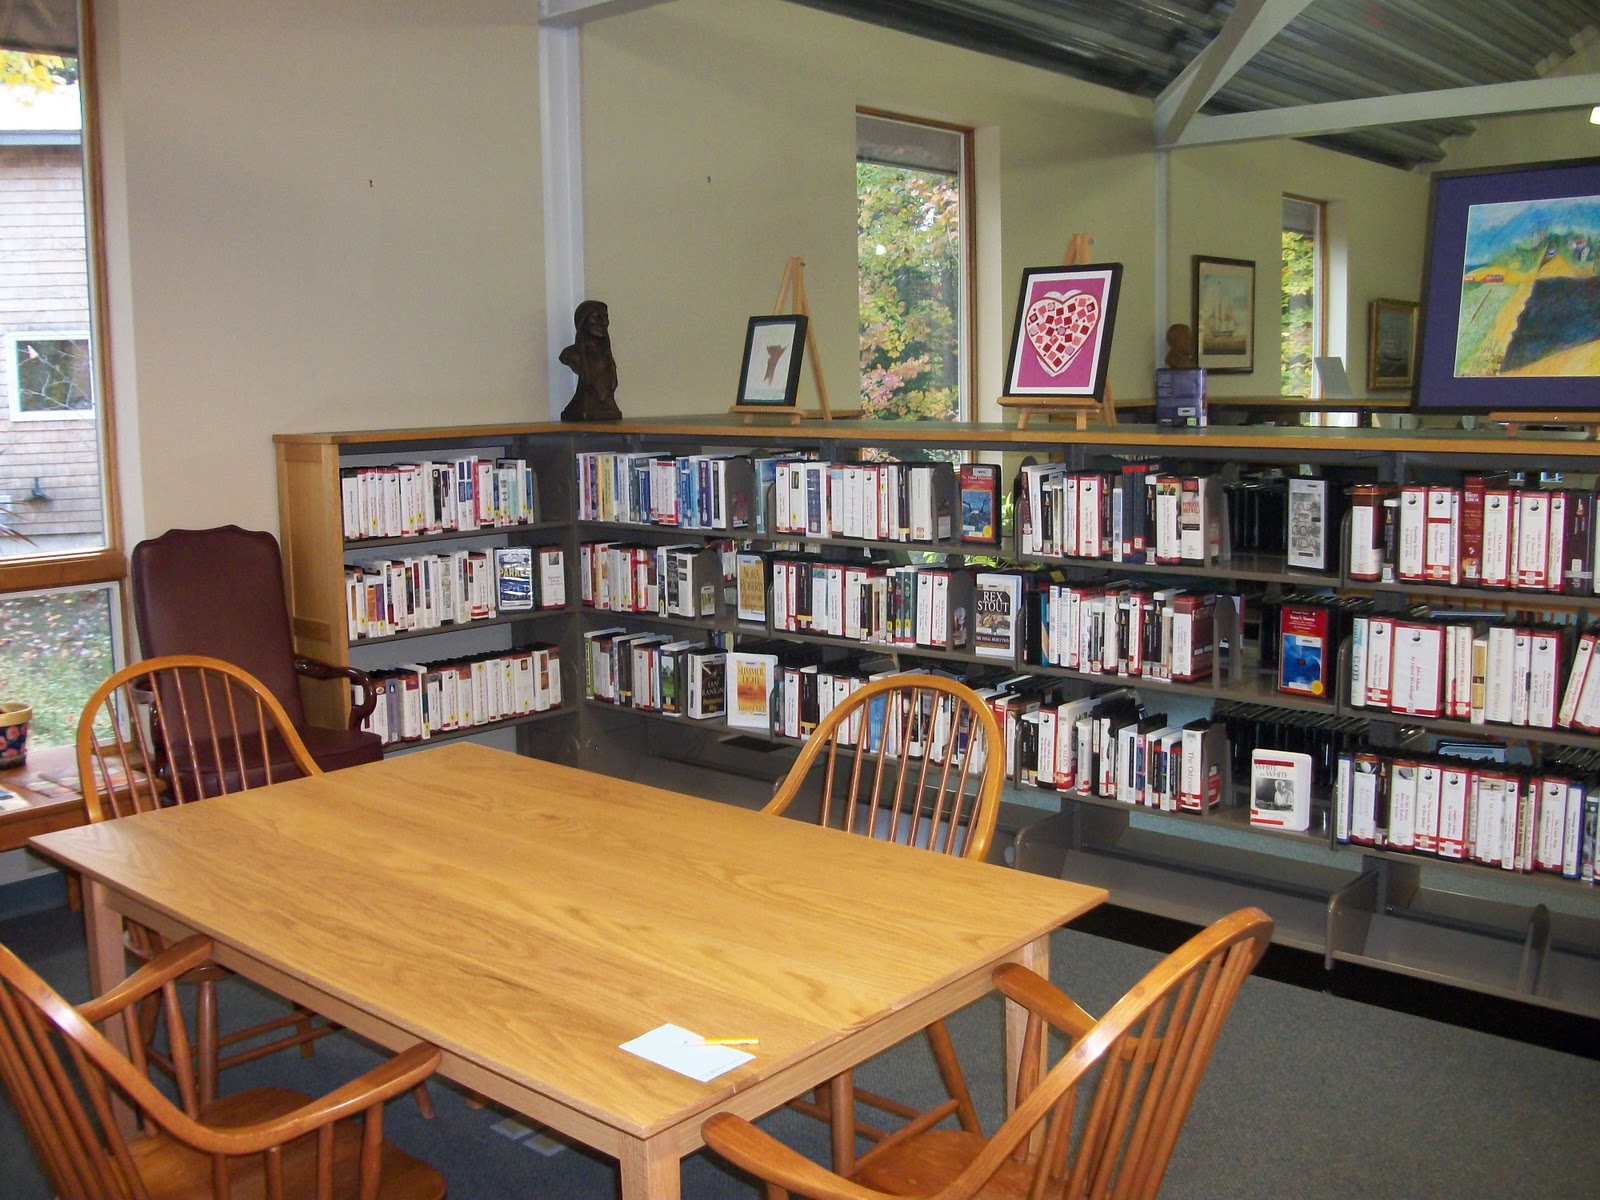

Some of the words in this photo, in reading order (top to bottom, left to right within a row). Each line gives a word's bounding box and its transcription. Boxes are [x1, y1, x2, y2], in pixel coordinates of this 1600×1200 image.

[983, 591, 1003, 602] REX
[978, 600, 1009, 612] STOUT
[707, 680, 718, 688] IAN
[702, 688, 724, 696] RANKIN
[1266, 771, 1288, 779] WHITE
